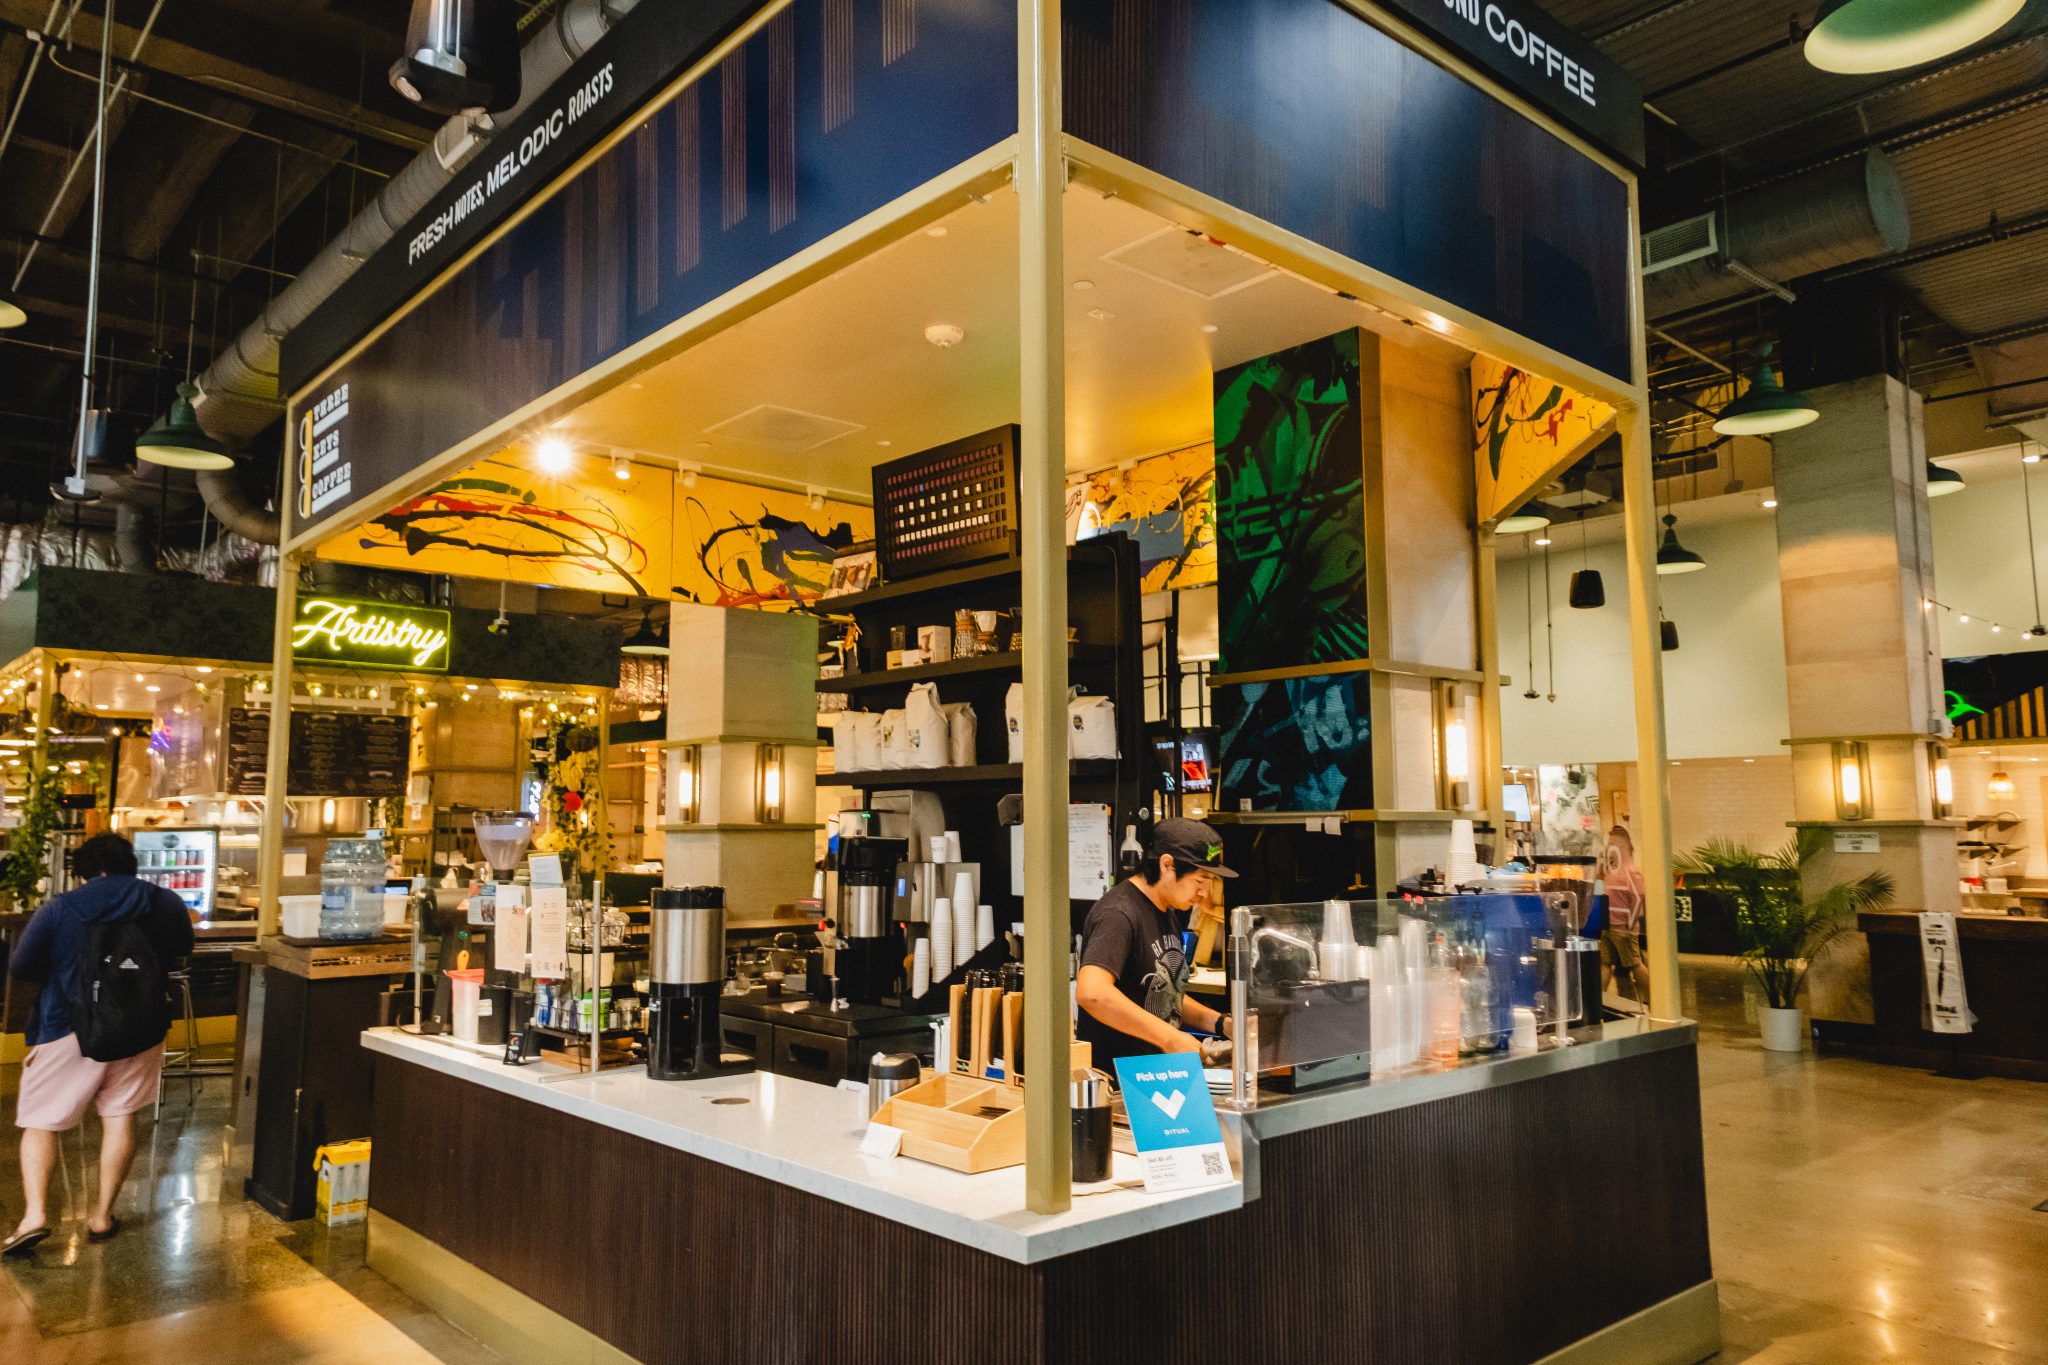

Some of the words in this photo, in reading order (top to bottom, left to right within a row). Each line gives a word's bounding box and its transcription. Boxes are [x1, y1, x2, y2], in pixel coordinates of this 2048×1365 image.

[1485, 4, 1596, 107] COFFEE
[408, 206, 454, 266] FRESH
[454, 180, 485, 226] NOTES,
[486, 108, 564, 198] MELODIC
[568, 62, 614, 126] ROASTS
[313, 383, 349, 422] THREE
[313, 429, 340, 461] KEYS
[312, 462, 351, 500] COFFEE
[292, 600, 447, 666] Artistry
[1136, 1072, 1155, 1082] Pick
[1156, 1072, 1168, 1083] up
[1168, 1070, 1188, 1079] here
